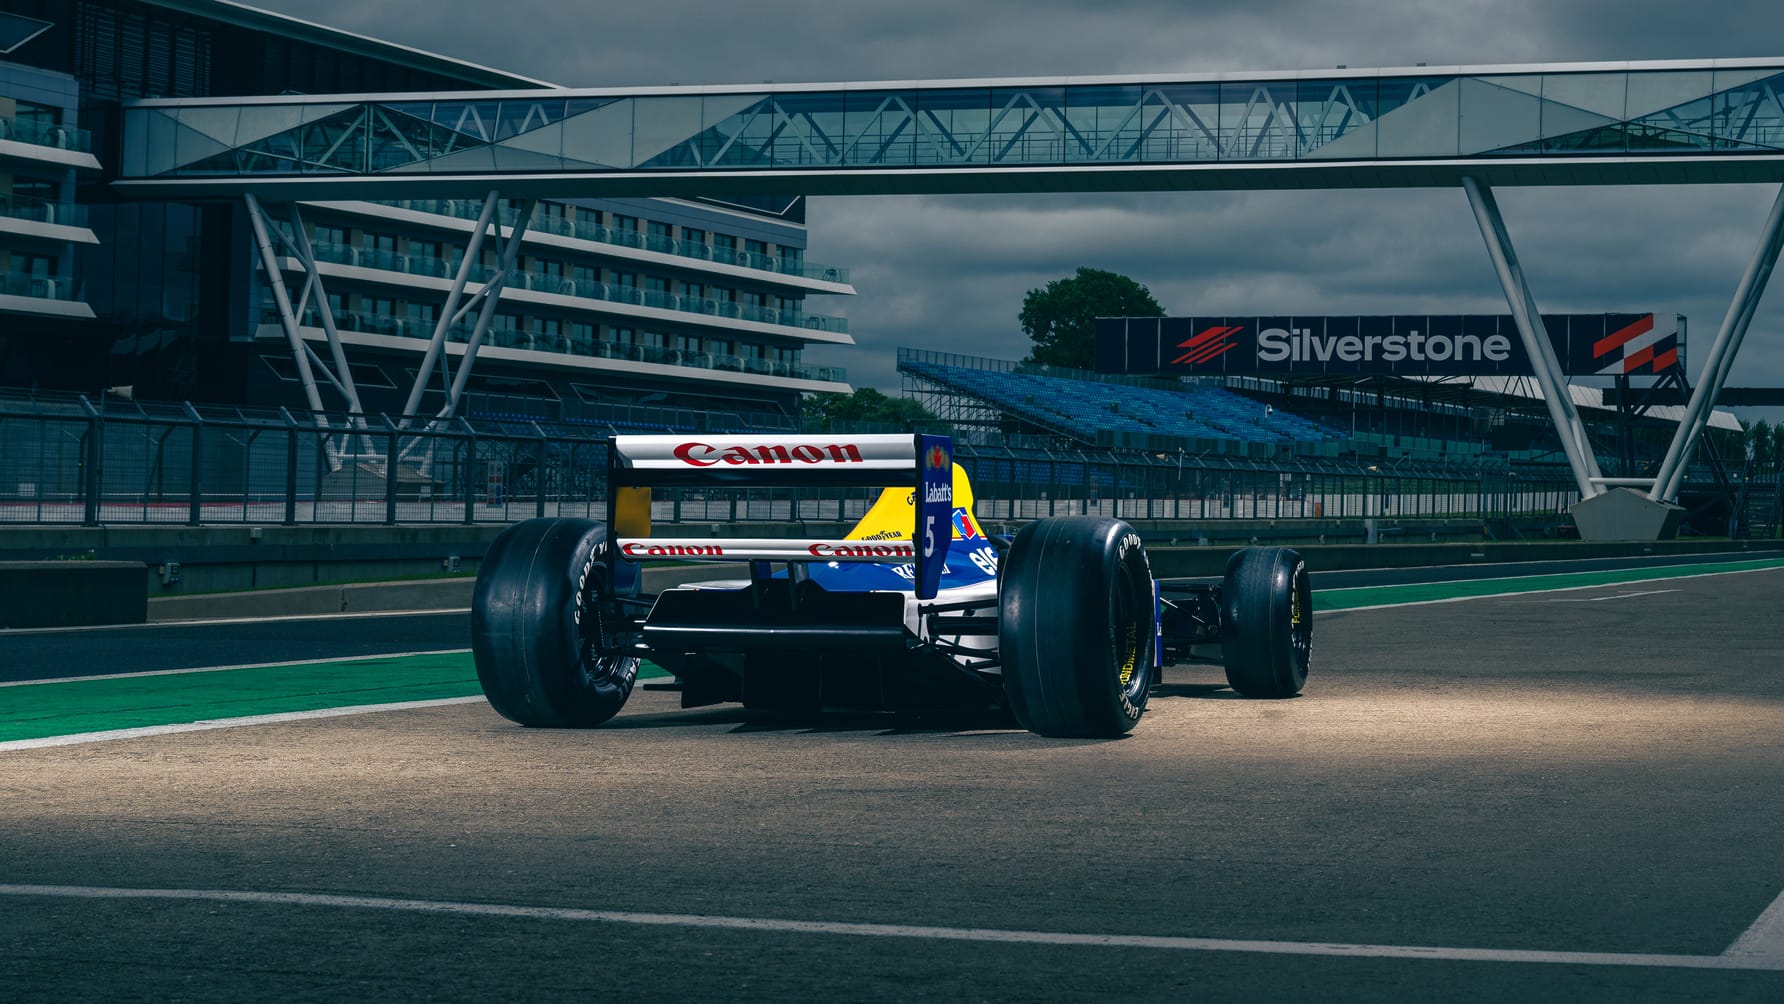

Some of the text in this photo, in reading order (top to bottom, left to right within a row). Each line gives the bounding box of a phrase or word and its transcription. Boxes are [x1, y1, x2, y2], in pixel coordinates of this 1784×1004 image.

[1256, 327, 1511, 363] Silverstone
[673, 442, 864, 467] Canon
[925, 482, 952, 503] Labatt's
[924, 515, 936, 559] 5
[622, 542, 724, 556] Canon
[807, 543, 913, 557] Canon
